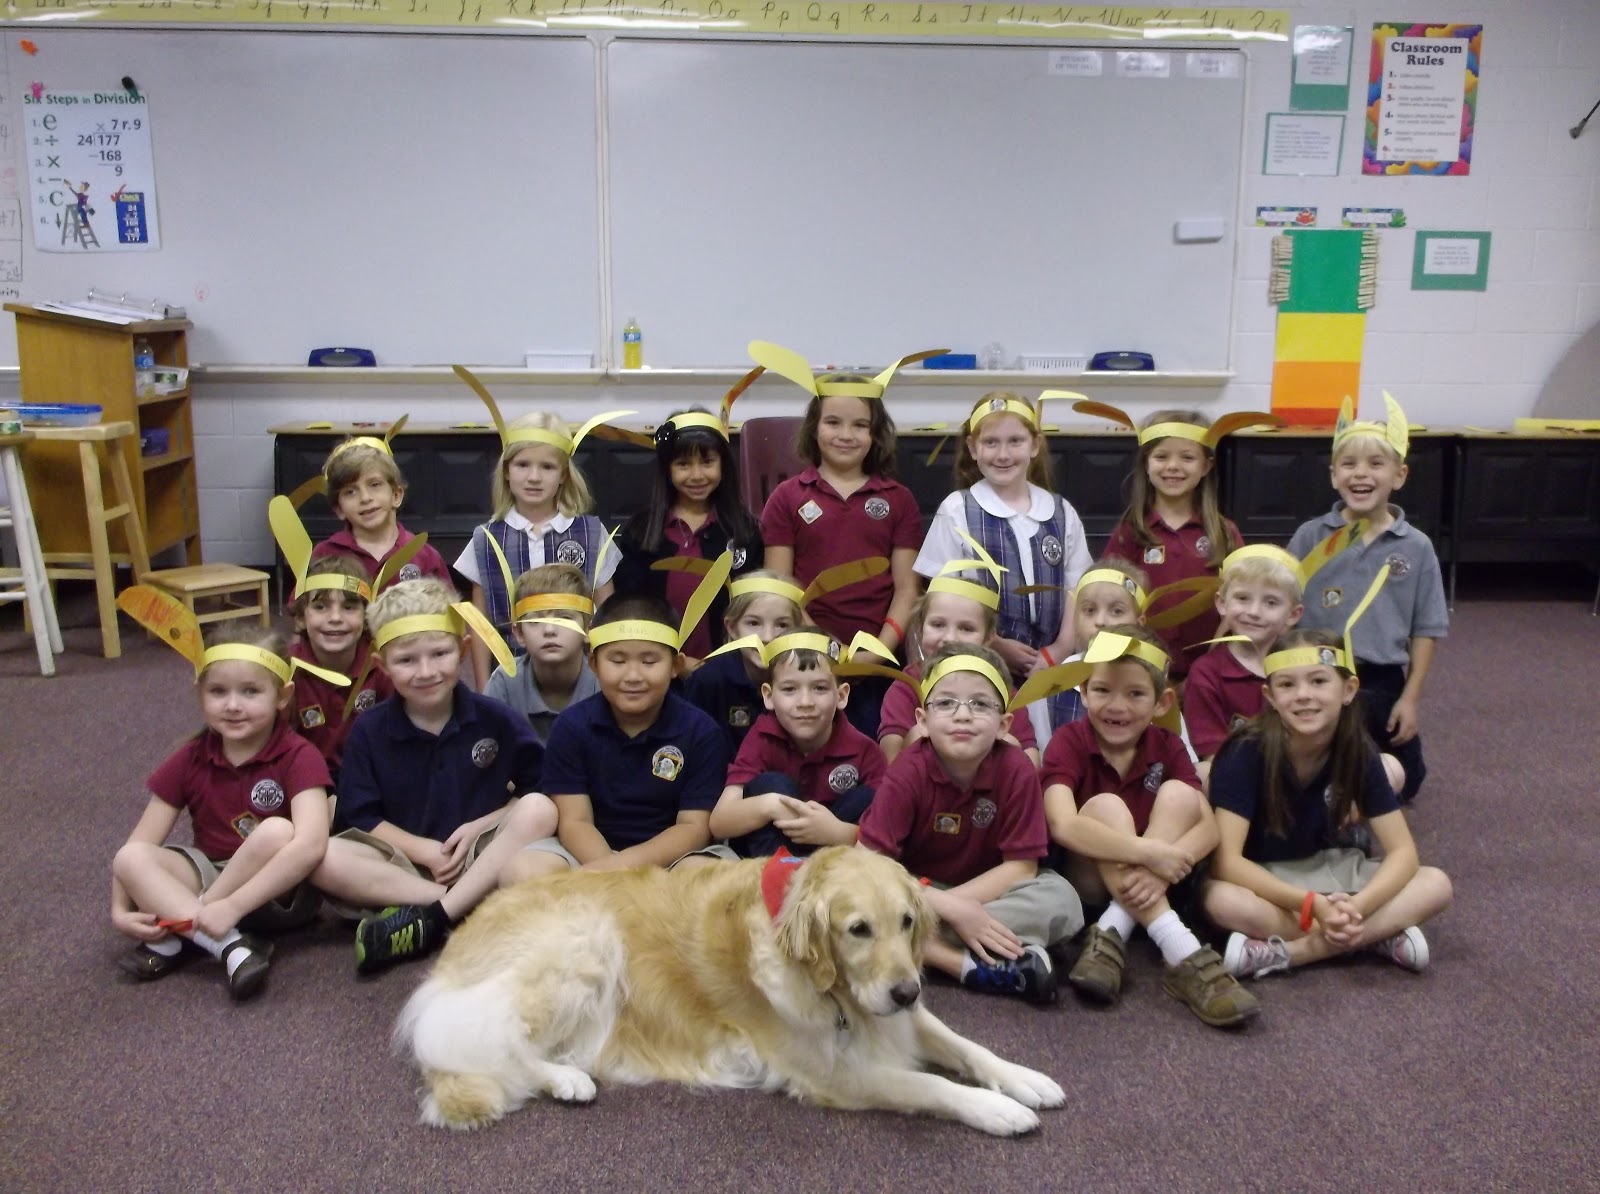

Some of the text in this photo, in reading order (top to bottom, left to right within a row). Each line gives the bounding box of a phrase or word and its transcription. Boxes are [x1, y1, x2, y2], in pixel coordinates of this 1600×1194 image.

[1391, 41, 1462, 54] Classroom
[1406, 54, 1445, 66] Rules
[24, 93, 42, 105] Six
[47, 94, 79, 107] Steps
[94, 93, 146, 105] Division
[111, 119, 119, 130] 7
[77, 134, 120, 146] 24 177
[115, 166, 123, 177] 9
